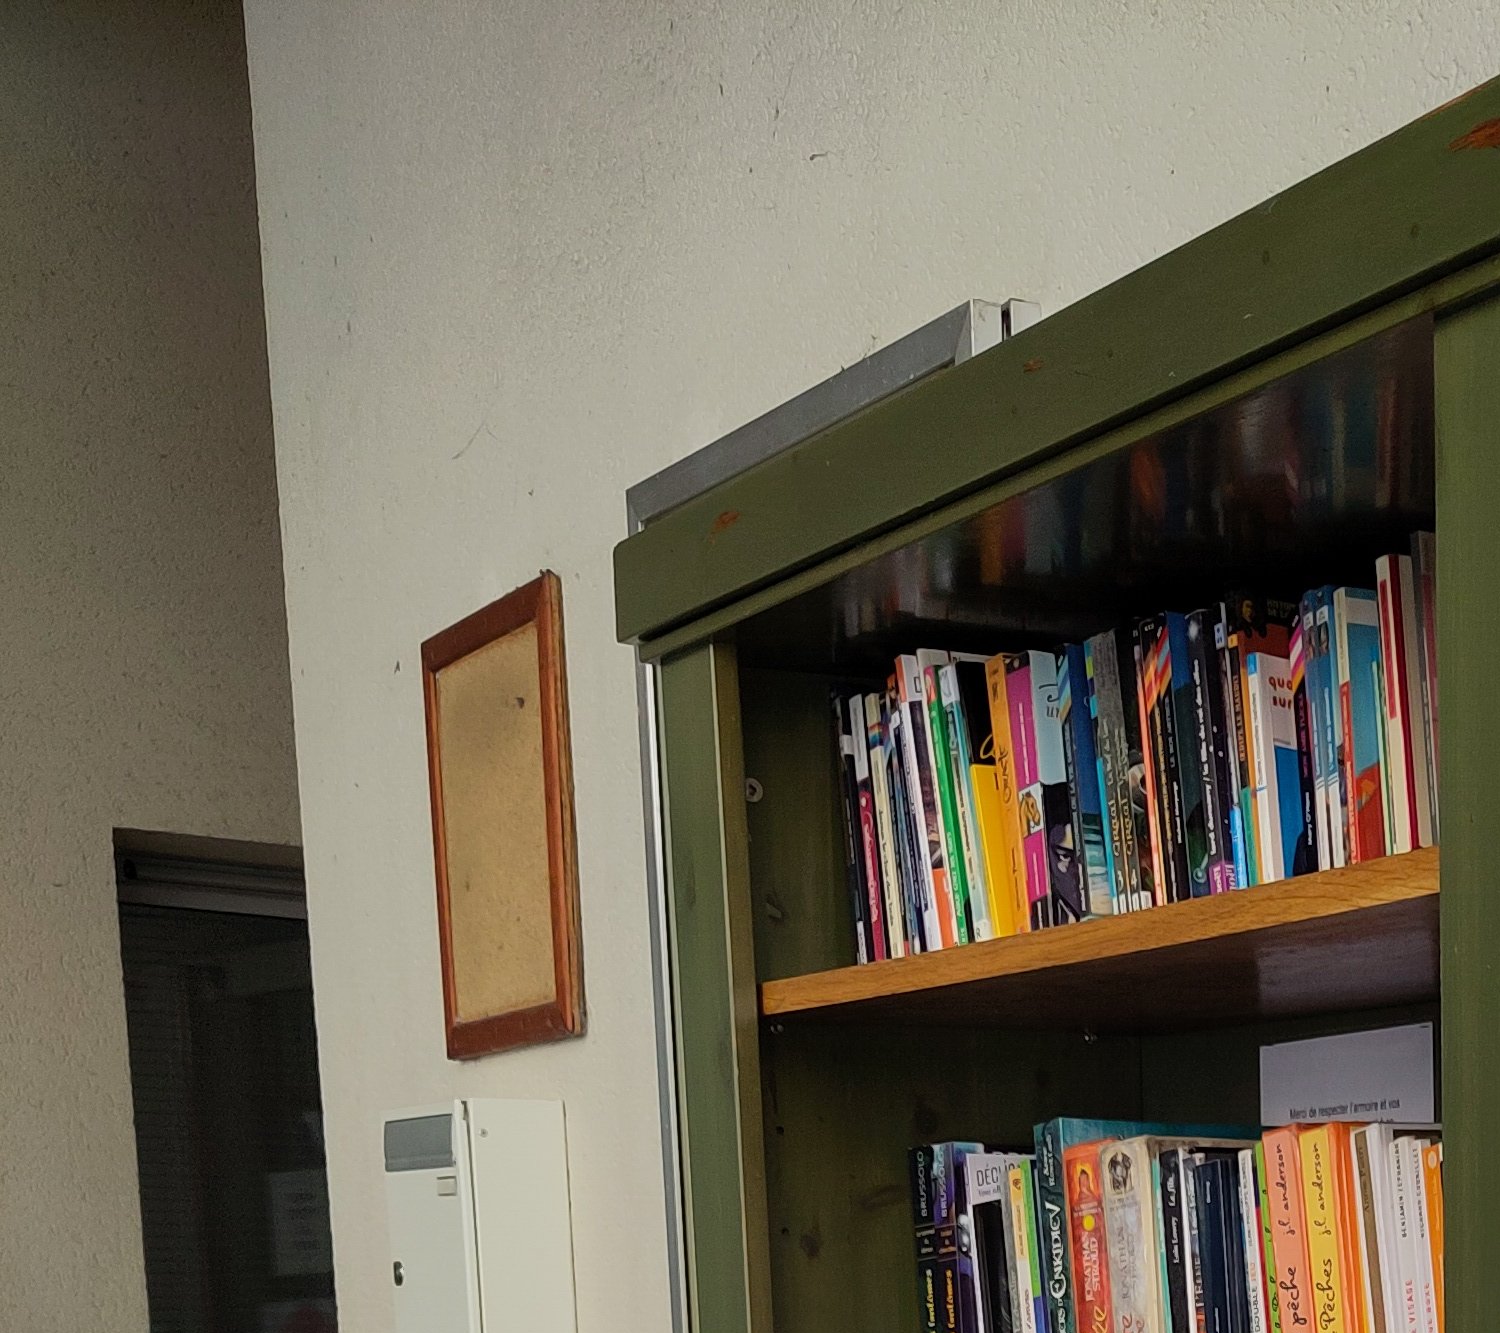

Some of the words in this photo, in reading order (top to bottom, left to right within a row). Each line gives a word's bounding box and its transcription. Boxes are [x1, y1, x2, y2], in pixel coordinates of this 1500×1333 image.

[916, 1151, 928, 1217] BRUSSOLO
[938, 1151, 948, 1218] BRUSSOLO
[1271, 1142, 1291, 1211] anderson
[1309, 1141, 1327, 1211] anderson
[1087, 1236, 1102, 1292] STROUD
[1276, 1264, 1307, 1327] pêche
[1312, 1256, 1339, 1330] Pêches
[1250, 1286, 1260, 1332] DOUBLE
[1404, 1278, 1416, 1323] VISAGE
